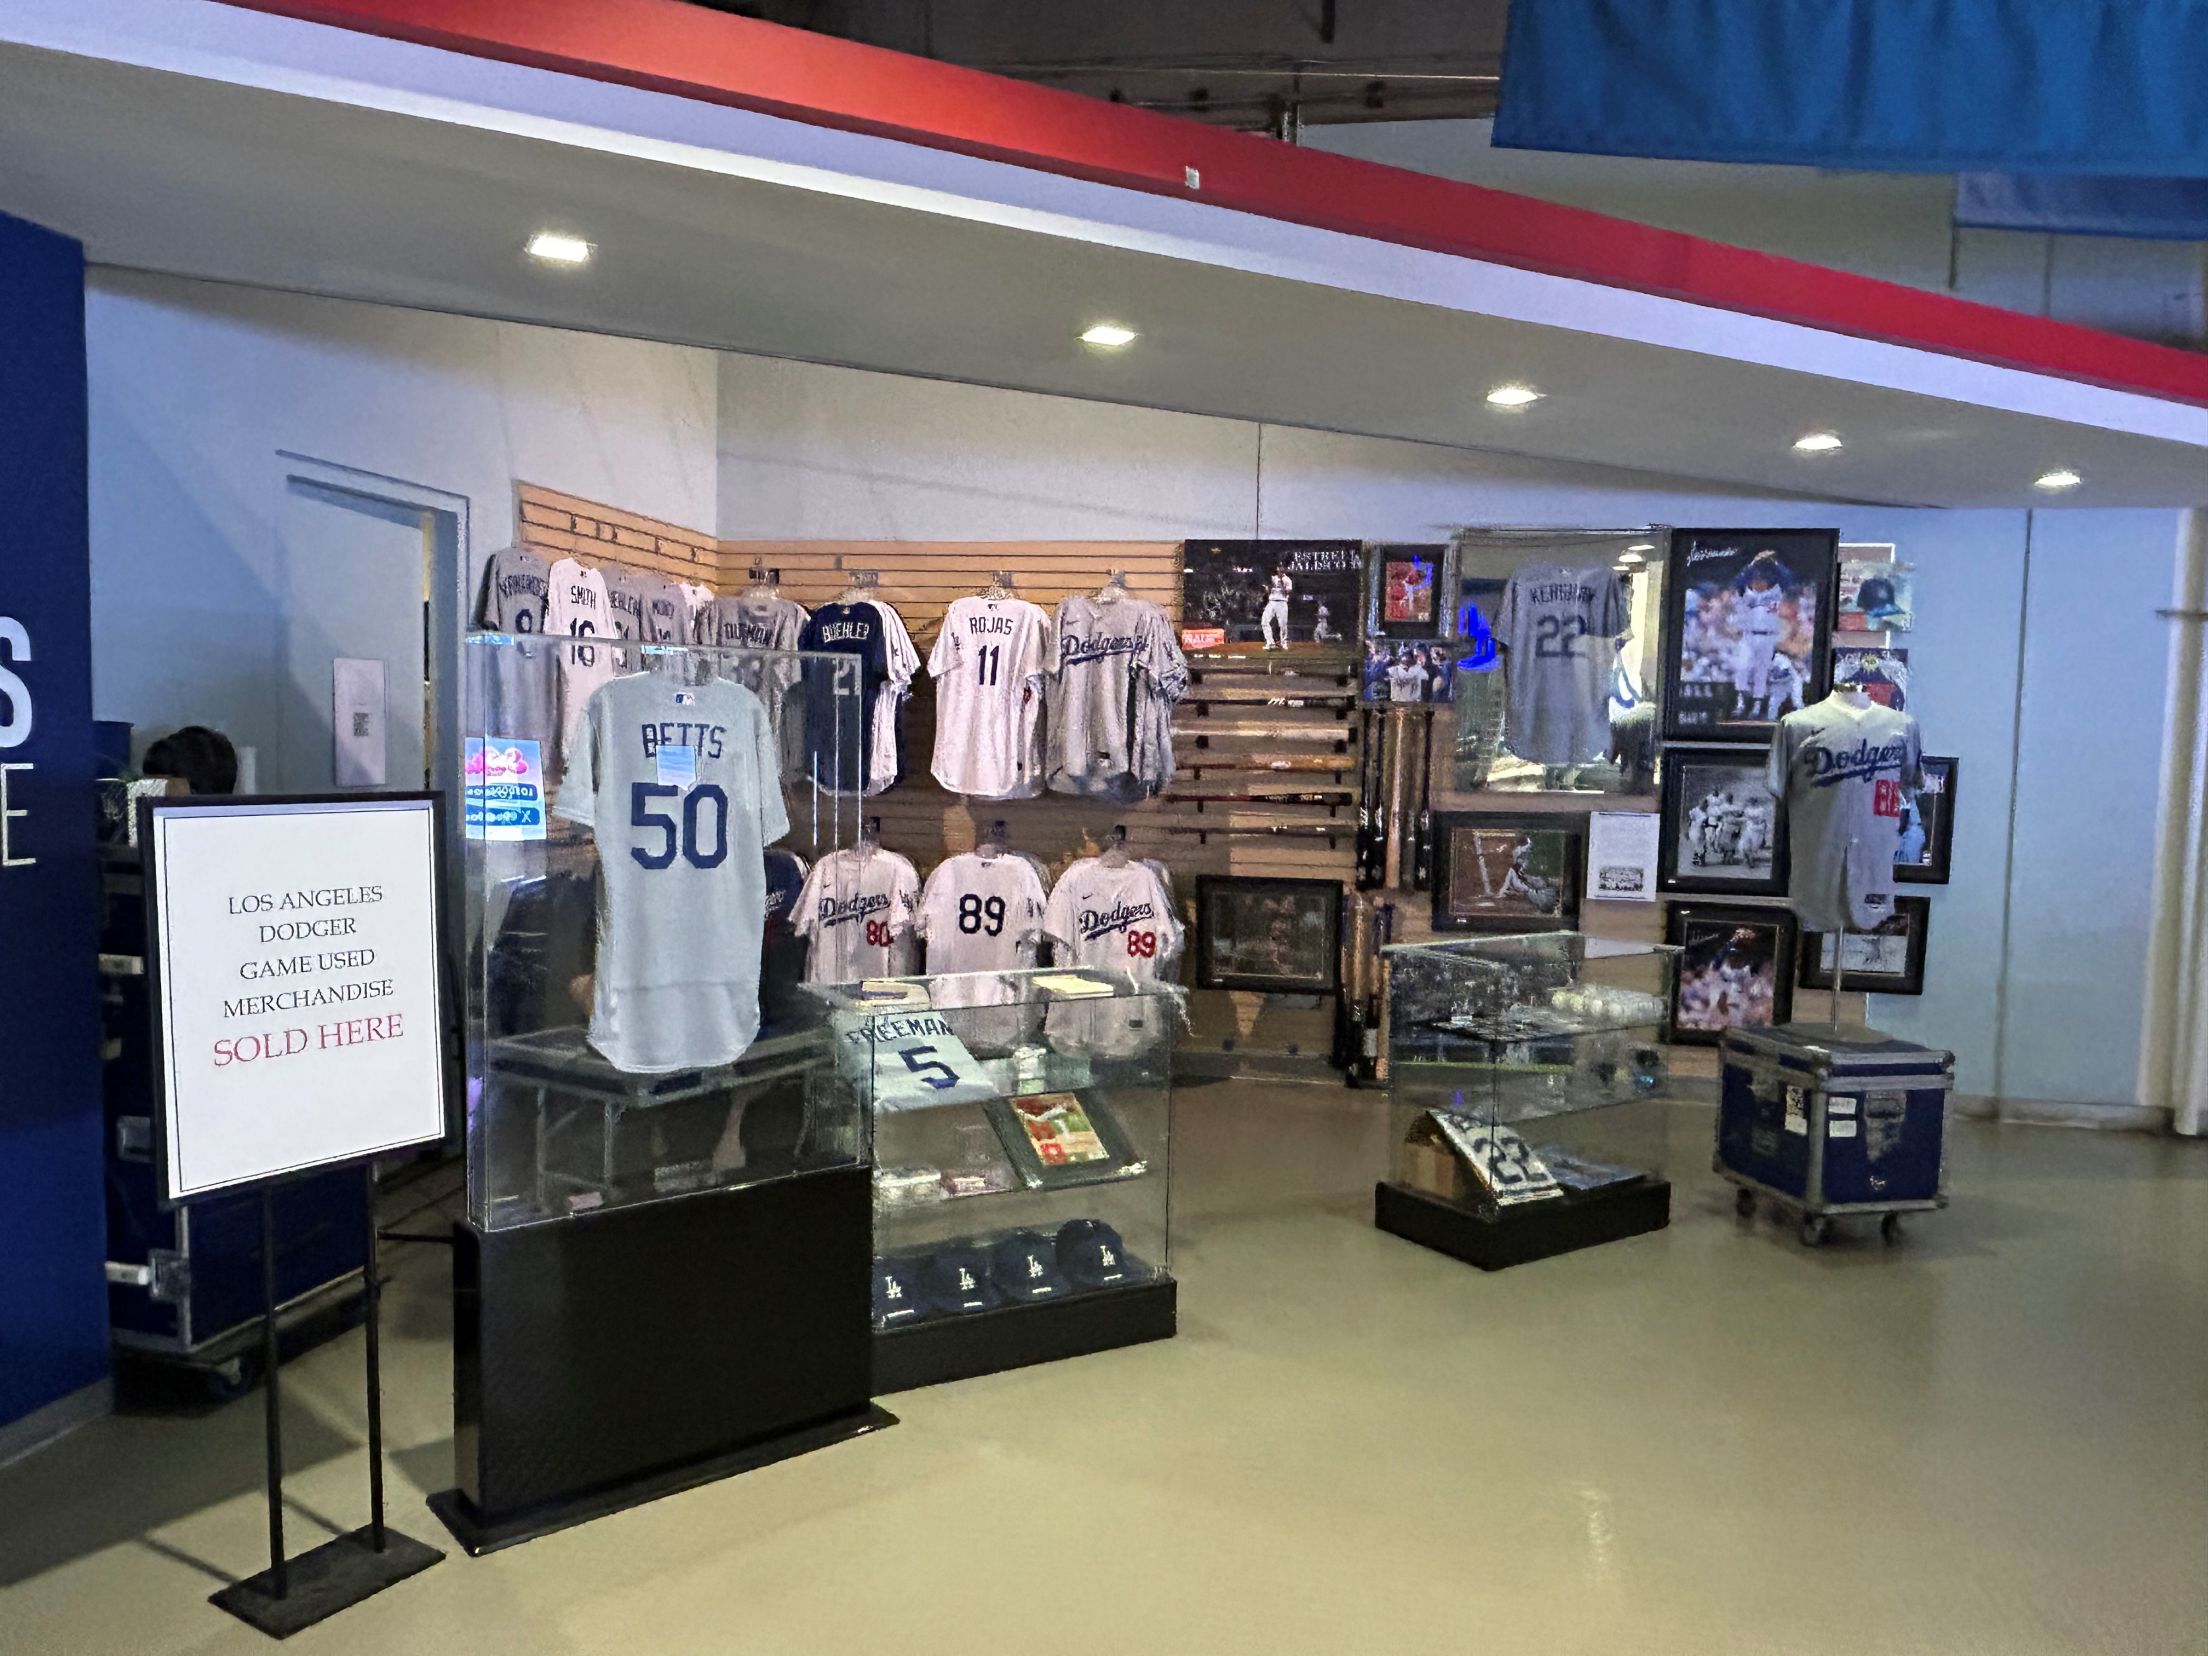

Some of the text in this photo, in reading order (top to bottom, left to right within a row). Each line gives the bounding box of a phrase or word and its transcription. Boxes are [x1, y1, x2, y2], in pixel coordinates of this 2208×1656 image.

[570, 585, 597, 610] SMITH
[822, 622, 870, 643] BUEHLER
[968, 616, 1014, 636] ROJAS
[1535, 614, 1586, 658] 22
[978, 644, 1000, 686] 11
[641, 721, 728, 759] BETTS
[1, 762, 37, 866] E
[630, 781, 729, 870] 50
[228, 885, 384, 915] LOS ANGELES
[818, 891, 892, 928] Dodgers
[959, 893, 1006, 937] 89
[259, 917, 357, 943] DODGER
[1078, 901, 1155, 942] Dodgers
[1126, 929, 1157, 959] 89
[239, 949, 376, 980] GAME USED
[223, 979, 395, 1018] MERCHANDISE
[213, 1013, 405, 1067] SOLD HERE
[898, 1045, 961, 1090] 5
[1027, 1255, 1044, 1279] LA
[1100, 1245, 1116, 1267] LA
[885, 1276, 903, 1299] LA
[959, 1268, 977, 1291] LA
